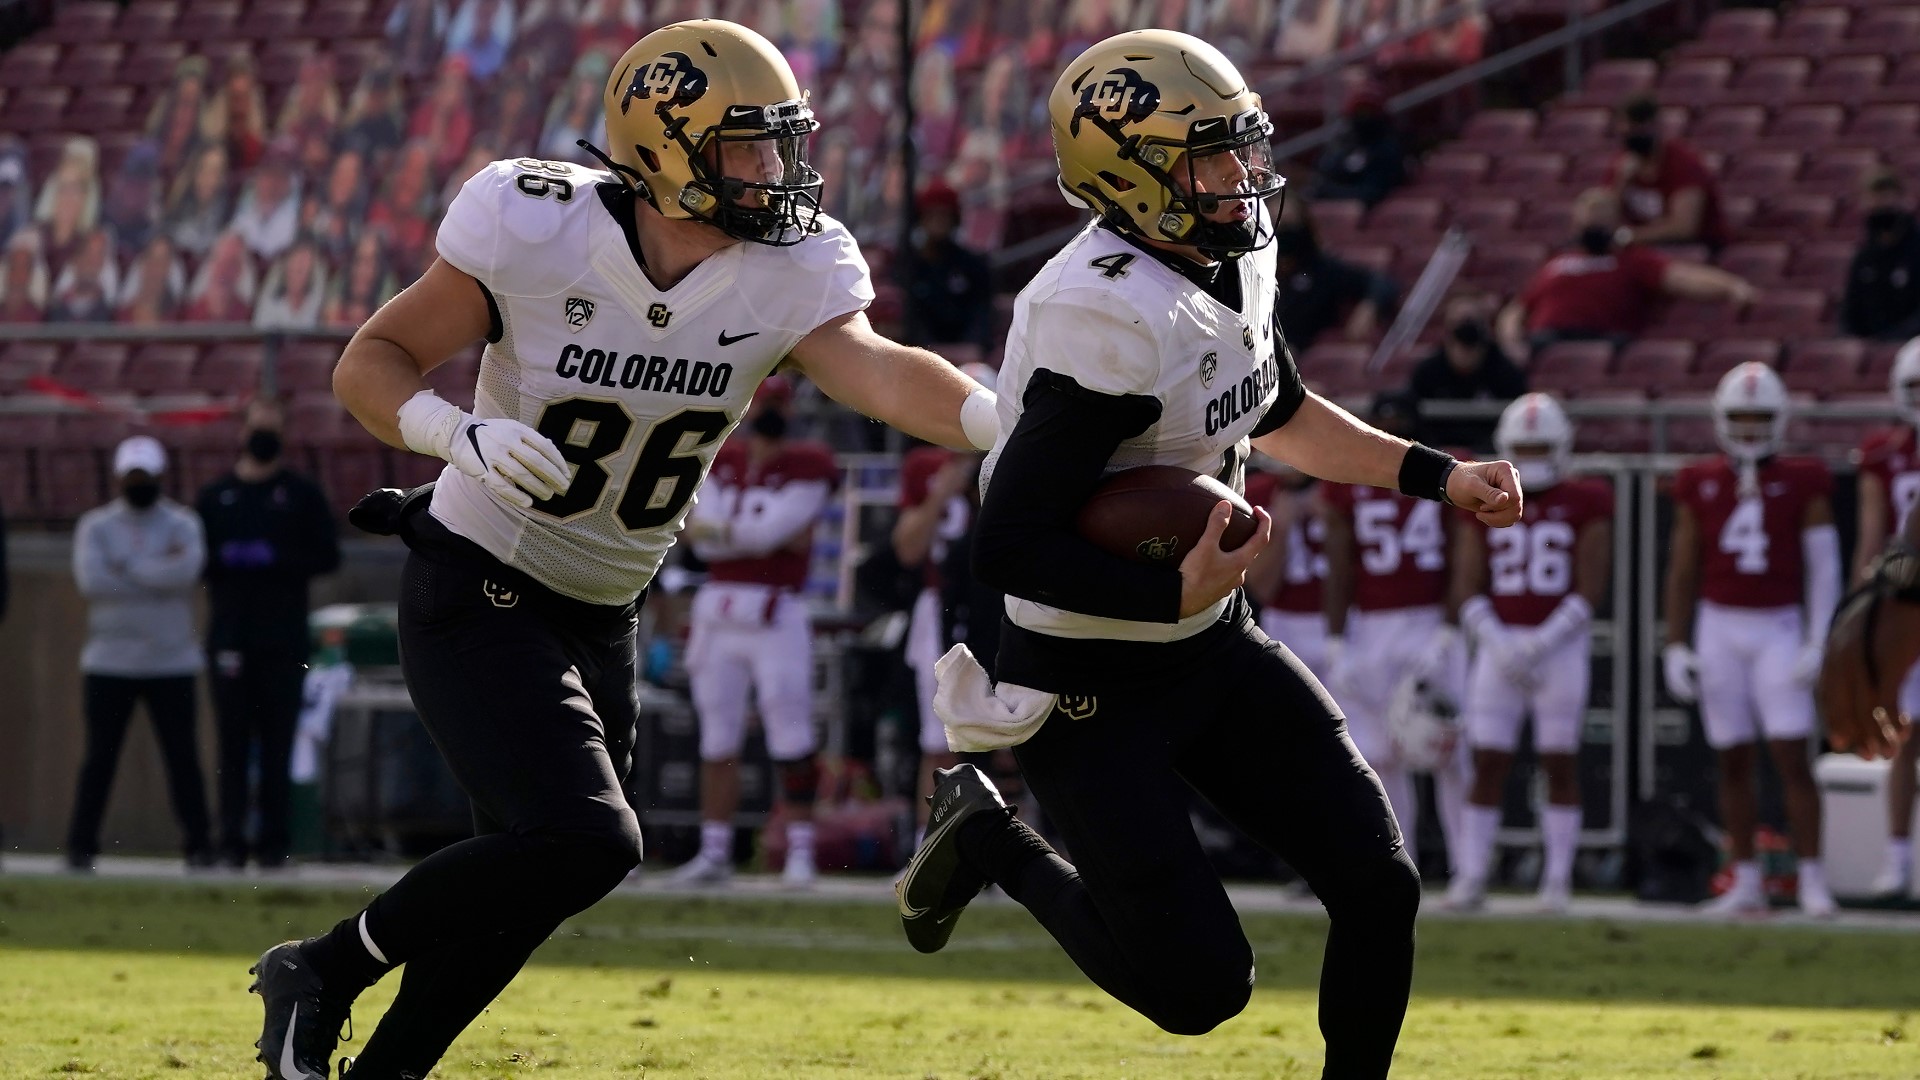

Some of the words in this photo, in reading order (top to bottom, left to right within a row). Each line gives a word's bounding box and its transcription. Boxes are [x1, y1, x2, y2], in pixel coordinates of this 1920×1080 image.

[1088, 252, 1139, 282] 4
[568, 312, 585, 326] 12
[555, 343, 734, 397] COLORADO
[528, 396, 735, 533] 86
[1354, 499, 1445, 575] 54
[1486, 522, 1575, 596] 26
[1718, 499, 1770, 575] 4
